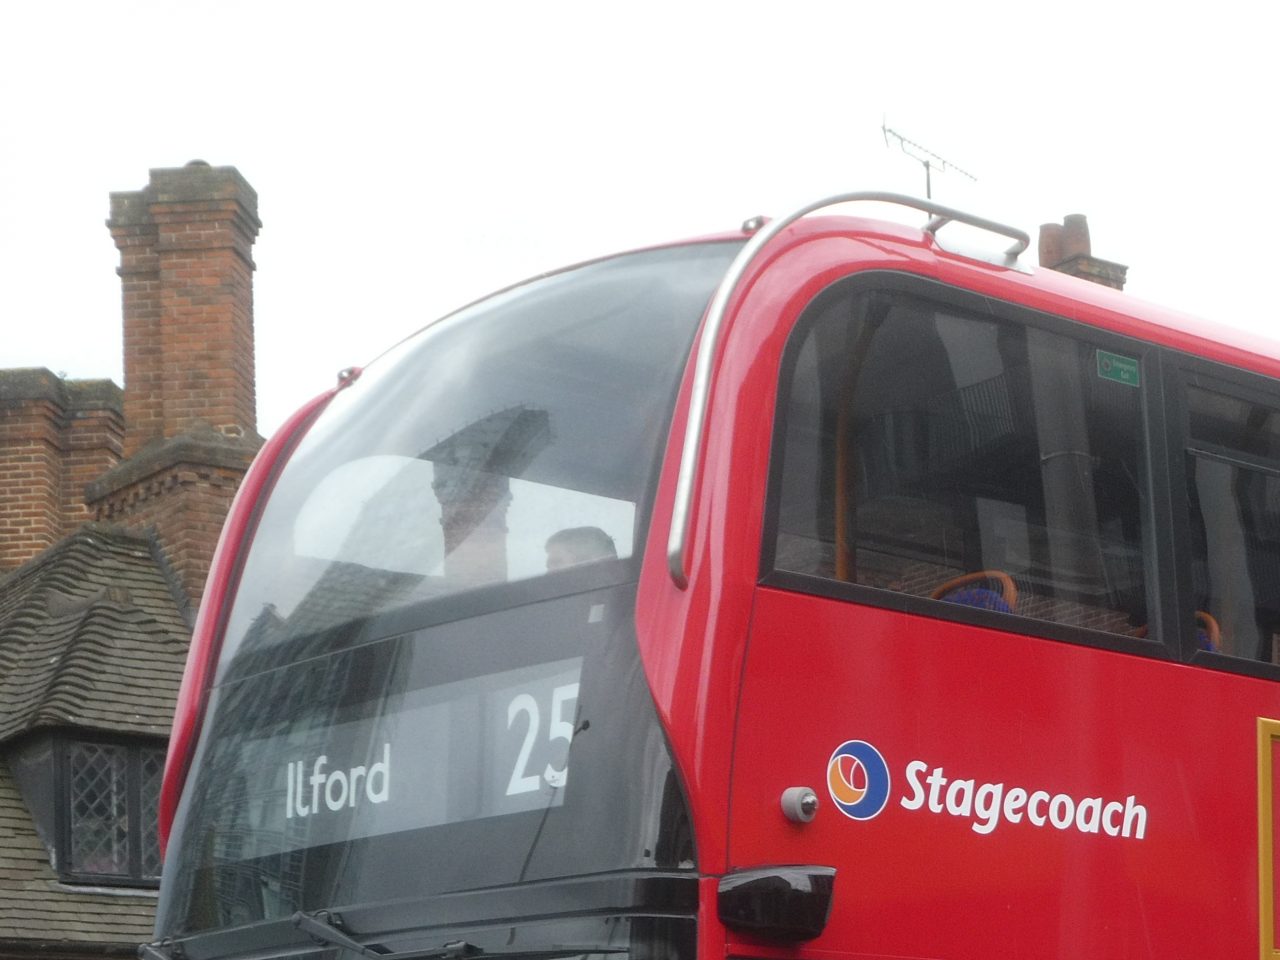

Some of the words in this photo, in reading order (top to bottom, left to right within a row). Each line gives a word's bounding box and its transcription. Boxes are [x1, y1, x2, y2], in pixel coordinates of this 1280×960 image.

[505, 682, 581, 797] 25
[286, 743, 390, 819] Ilford
[900, 760, 1147, 840] Stagecoach
